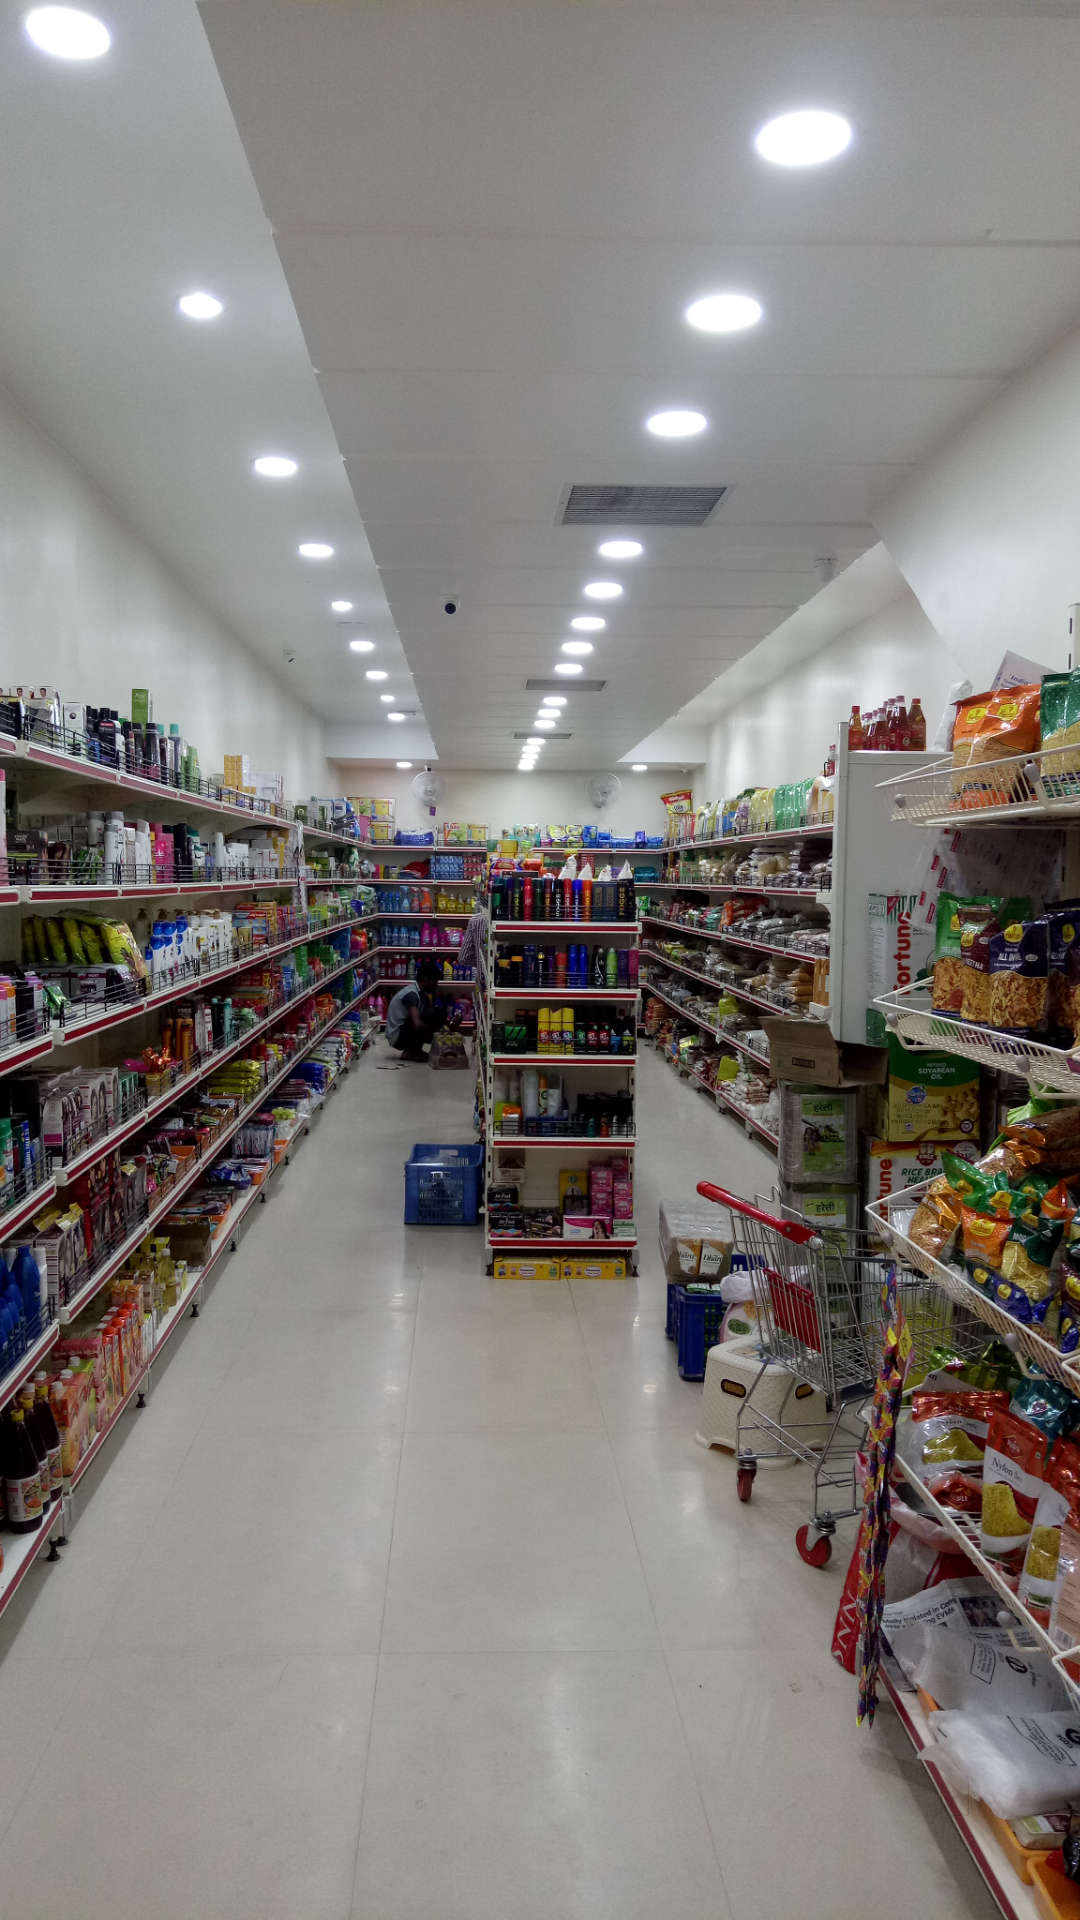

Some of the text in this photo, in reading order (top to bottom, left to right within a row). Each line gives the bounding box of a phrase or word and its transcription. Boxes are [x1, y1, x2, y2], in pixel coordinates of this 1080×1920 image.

[917, 1067, 956, 1075] SOYABEAN
[901, 1167, 944, 1177] RICE BRA
[992, 1457, 1013, 1478] Nylon
